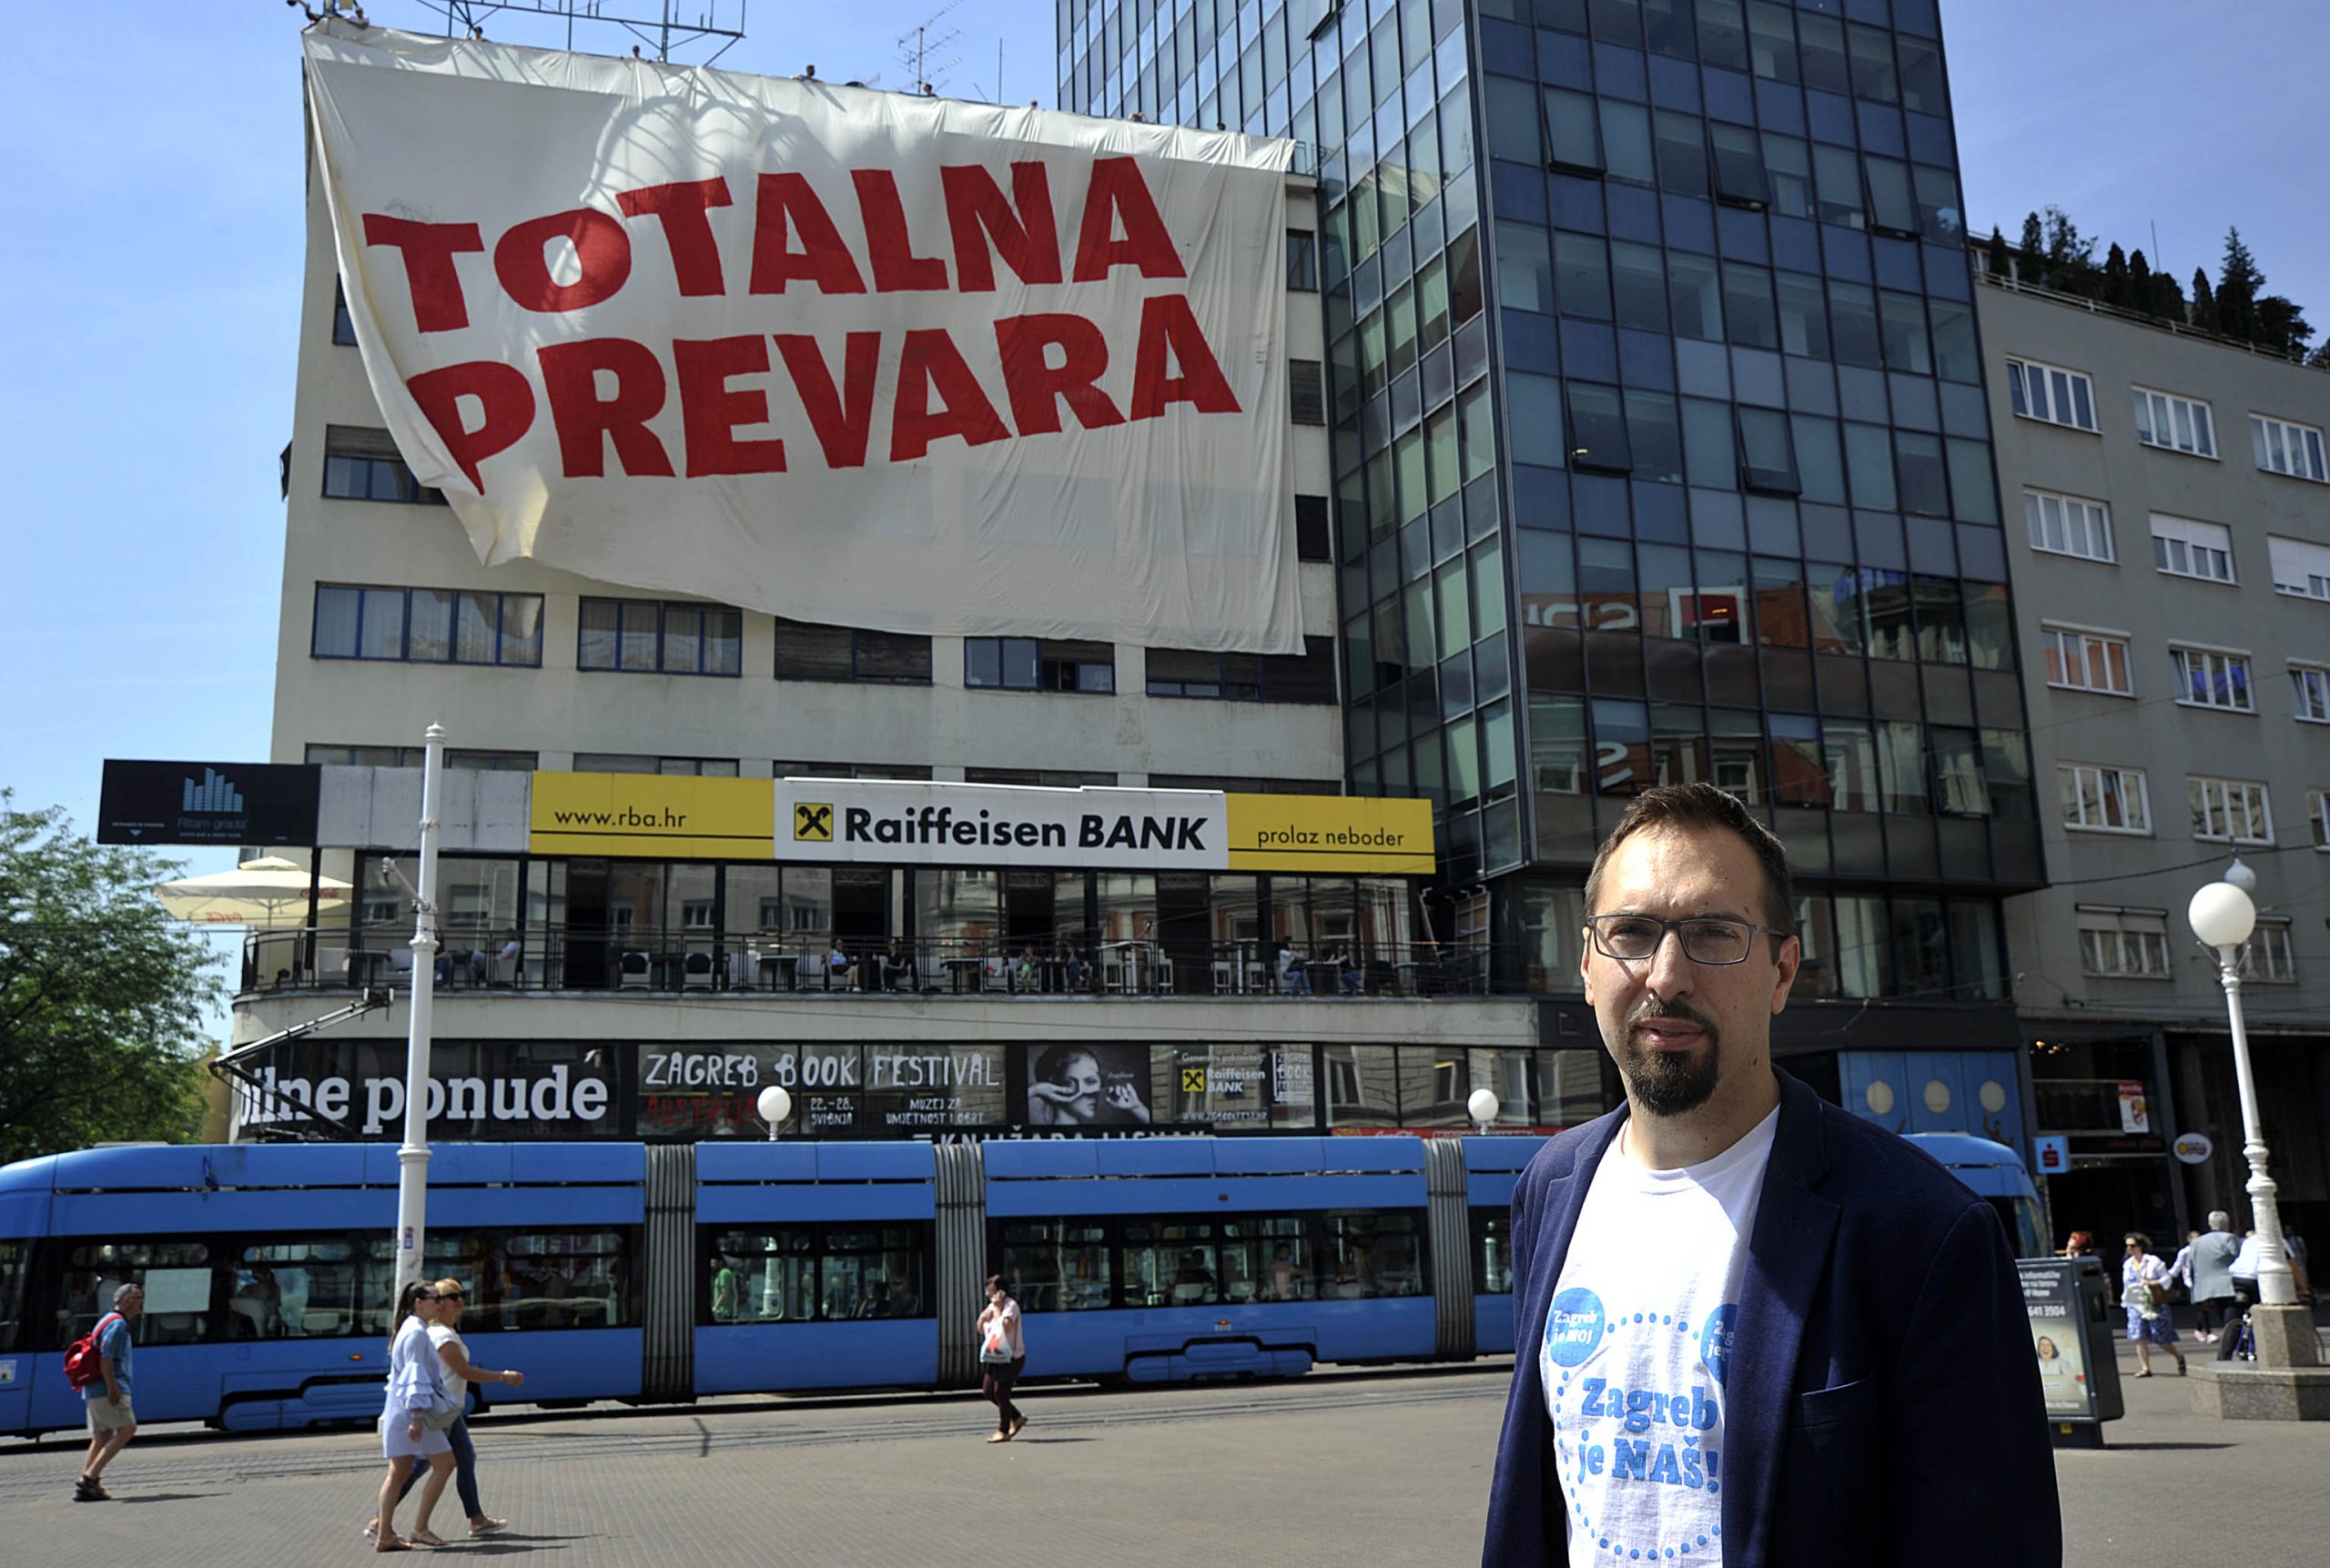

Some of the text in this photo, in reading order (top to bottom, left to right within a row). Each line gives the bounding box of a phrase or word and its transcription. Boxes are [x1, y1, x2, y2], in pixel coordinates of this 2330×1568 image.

[361, 156, 1188, 333] TOTALNA
[406, 293, 1243, 495] PREVARA
[553, 805, 686, 829] www.rba.hr
[845, 806, 1210, 851] Raiffeisen BANK
[1258, 825, 1404, 848] prolaz neboder
[644, 1051, 1000, 1087] ZAGREB BOOK FESTIVAL
[1206, 1067, 1266, 1080] Raiffeisen
[361, 1064, 609, 1135] ponude
[1207, 1081, 1244, 1093] BANK
[909, 1097, 962, 1110] MUZEJ ZA
[886, 1112, 947, 1126] UMJETNOST
[1553, 1309, 1599, 1328] Zagreb
[1580, 1377, 1719, 1433] Zagreb
[1576, 1429, 1720, 1494] je NAŠ!
